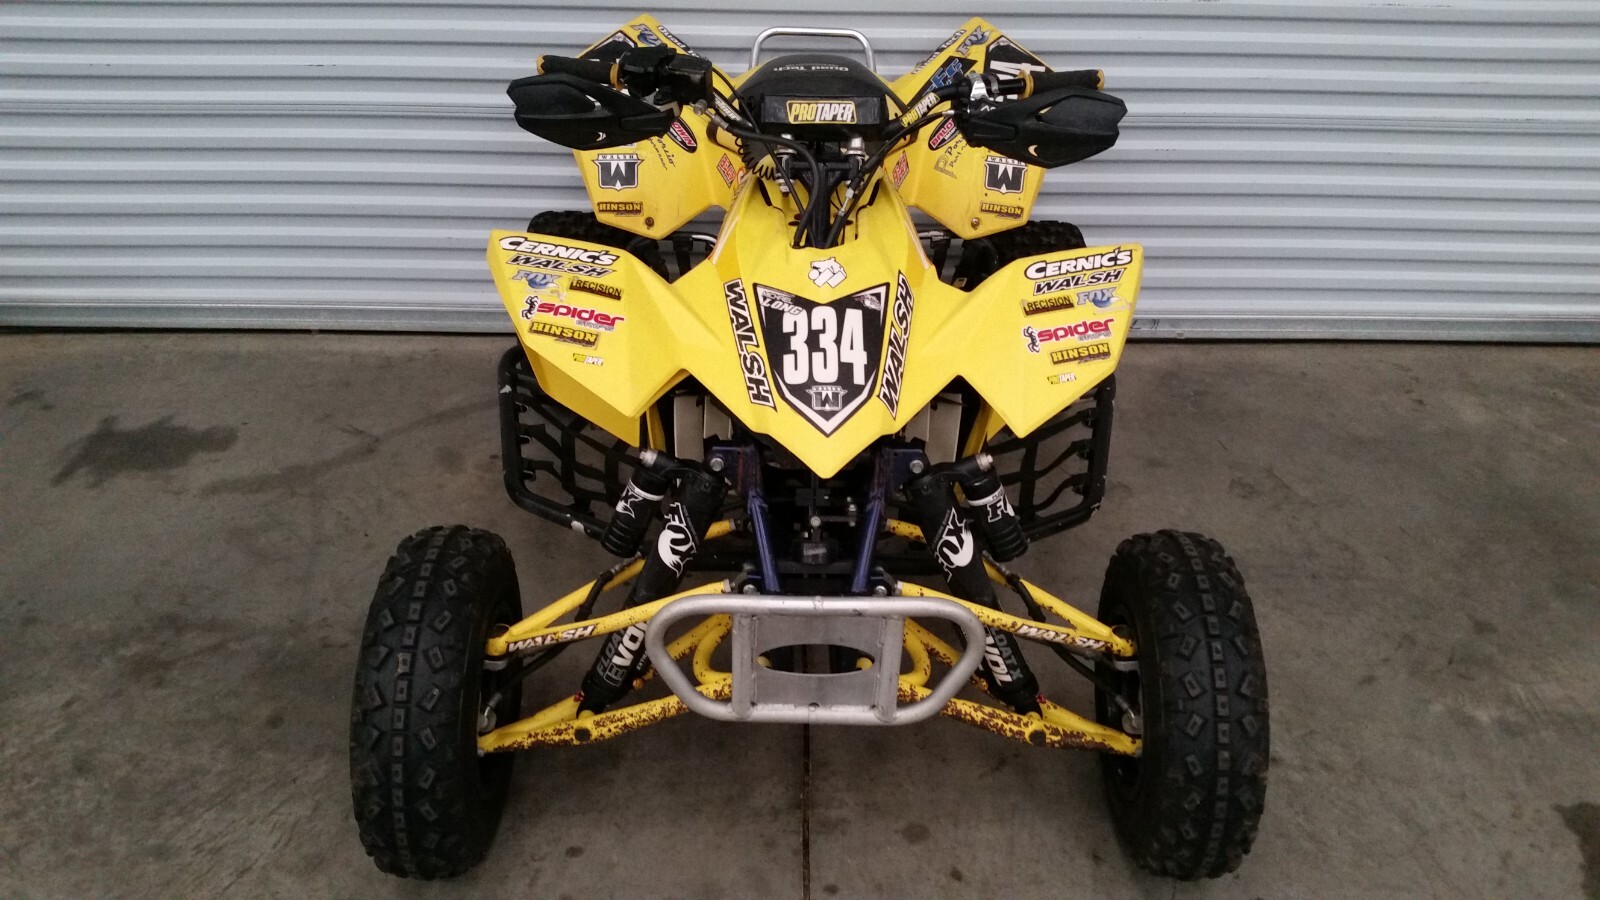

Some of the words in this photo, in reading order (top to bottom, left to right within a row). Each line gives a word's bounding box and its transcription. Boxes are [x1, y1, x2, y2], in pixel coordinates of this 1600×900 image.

[956, 26, 985, 55] FOX
[791, 102, 855, 122] PROTAPER
[900, 94, 938, 127] PROTAPER
[600, 161, 635, 187] W
[987, 164, 1024, 190] W
[598, 202, 641, 214] HINSON
[981, 203, 1022, 215] HINSON
[499, 236, 620, 266] CERNIC'S
[1025, 247, 1133, 280] CERNIC'S
[506, 253, 617, 278] WALSH
[512, 269, 563, 289] FOX
[1033, 268, 1125, 296] WALSH
[760, 298, 804, 315] LONG
[1077, 287, 1117, 308] FOX
[537, 302, 624, 327] spider
[531, 322, 599, 342] HINSON
[1038, 318, 1114, 342] spider
[724, 278, 778, 412] WALSH
[782, 306, 868, 386] 334
[877, 270, 915, 420] WALSH
[1051, 343, 1110, 363] HINSON
[986, 494, 1015, 523] FO
[507, 625, 595, 652] WALSH
[1015, 624, 1107, 650] WALSH
[597, 629, 625, 677] FLOA
[984, 634, 1013, 687] VOL
